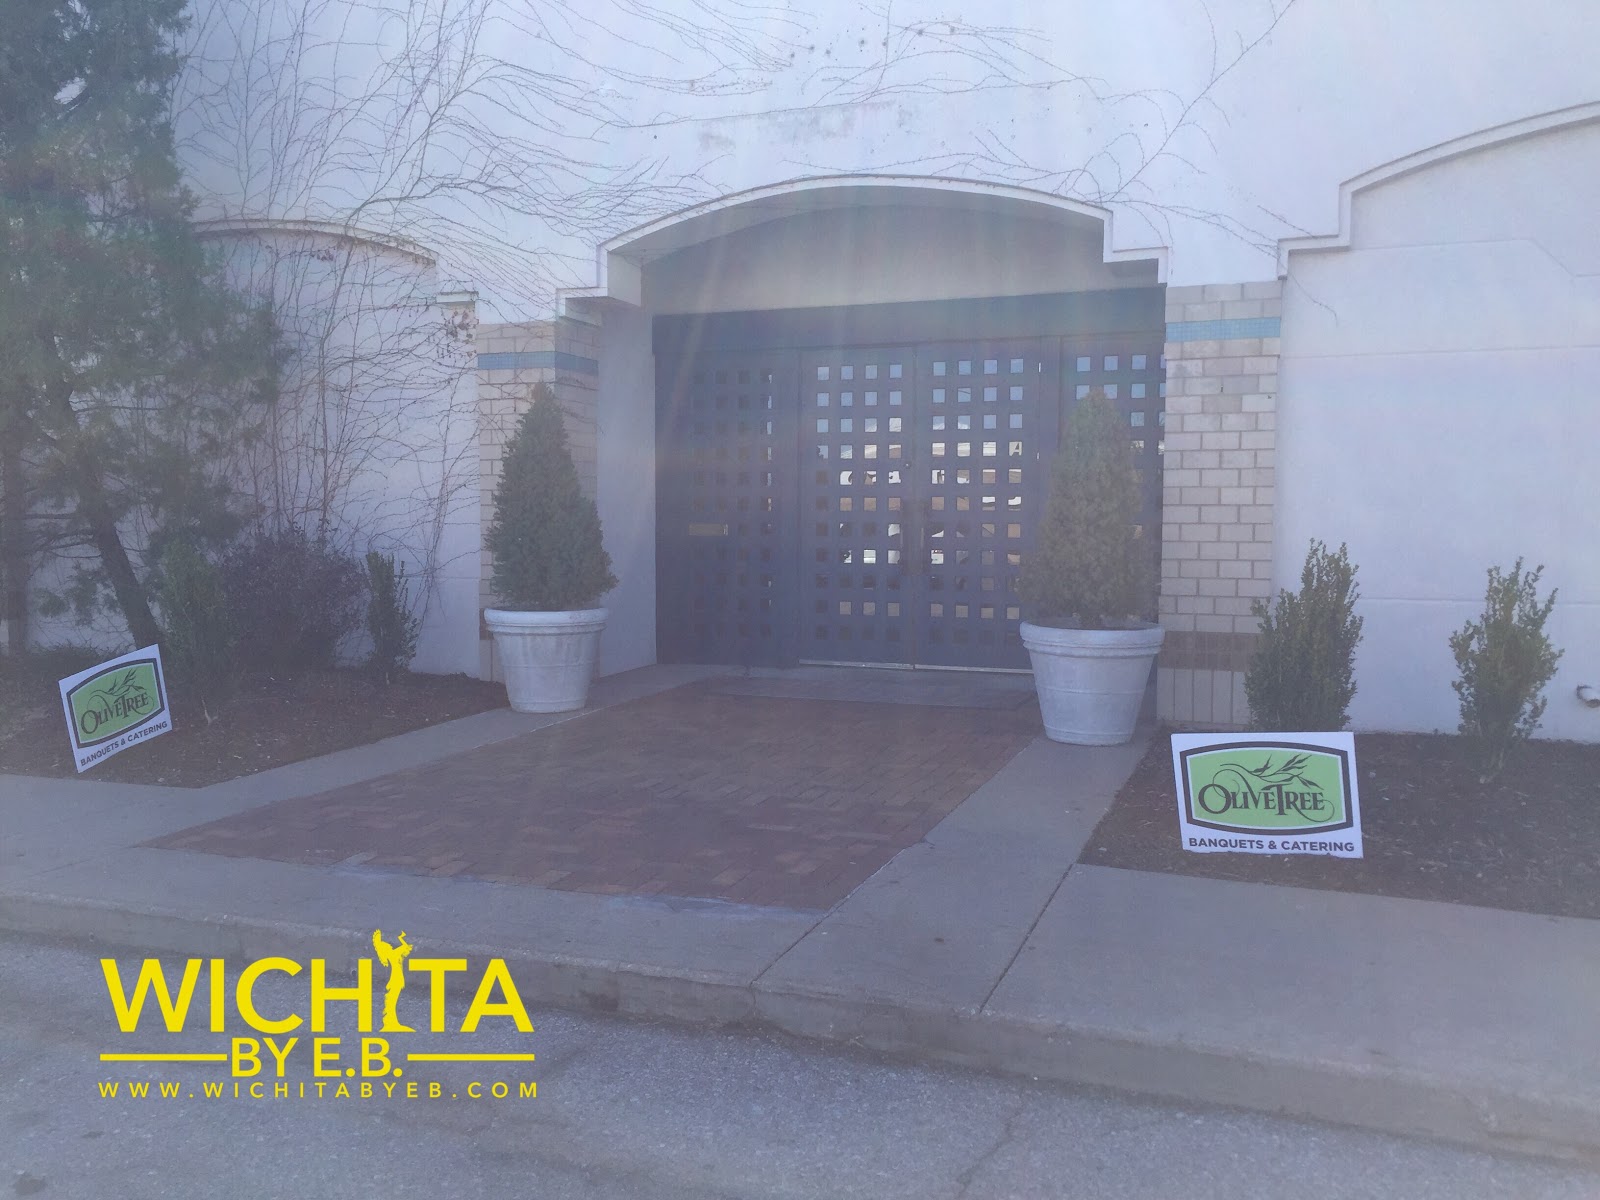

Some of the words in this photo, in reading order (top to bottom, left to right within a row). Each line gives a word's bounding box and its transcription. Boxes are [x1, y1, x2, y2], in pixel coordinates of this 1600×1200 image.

[80, 741, 119, 766] BANQUETS
[120, 738, 126, 746] &
[127, 721, 167, 742] CATERING
[1188, 837, 1264, 850] BANQUETS
[1268, 840, 1278, 850] &
[1280, 840, 1355, 852] CATERING
